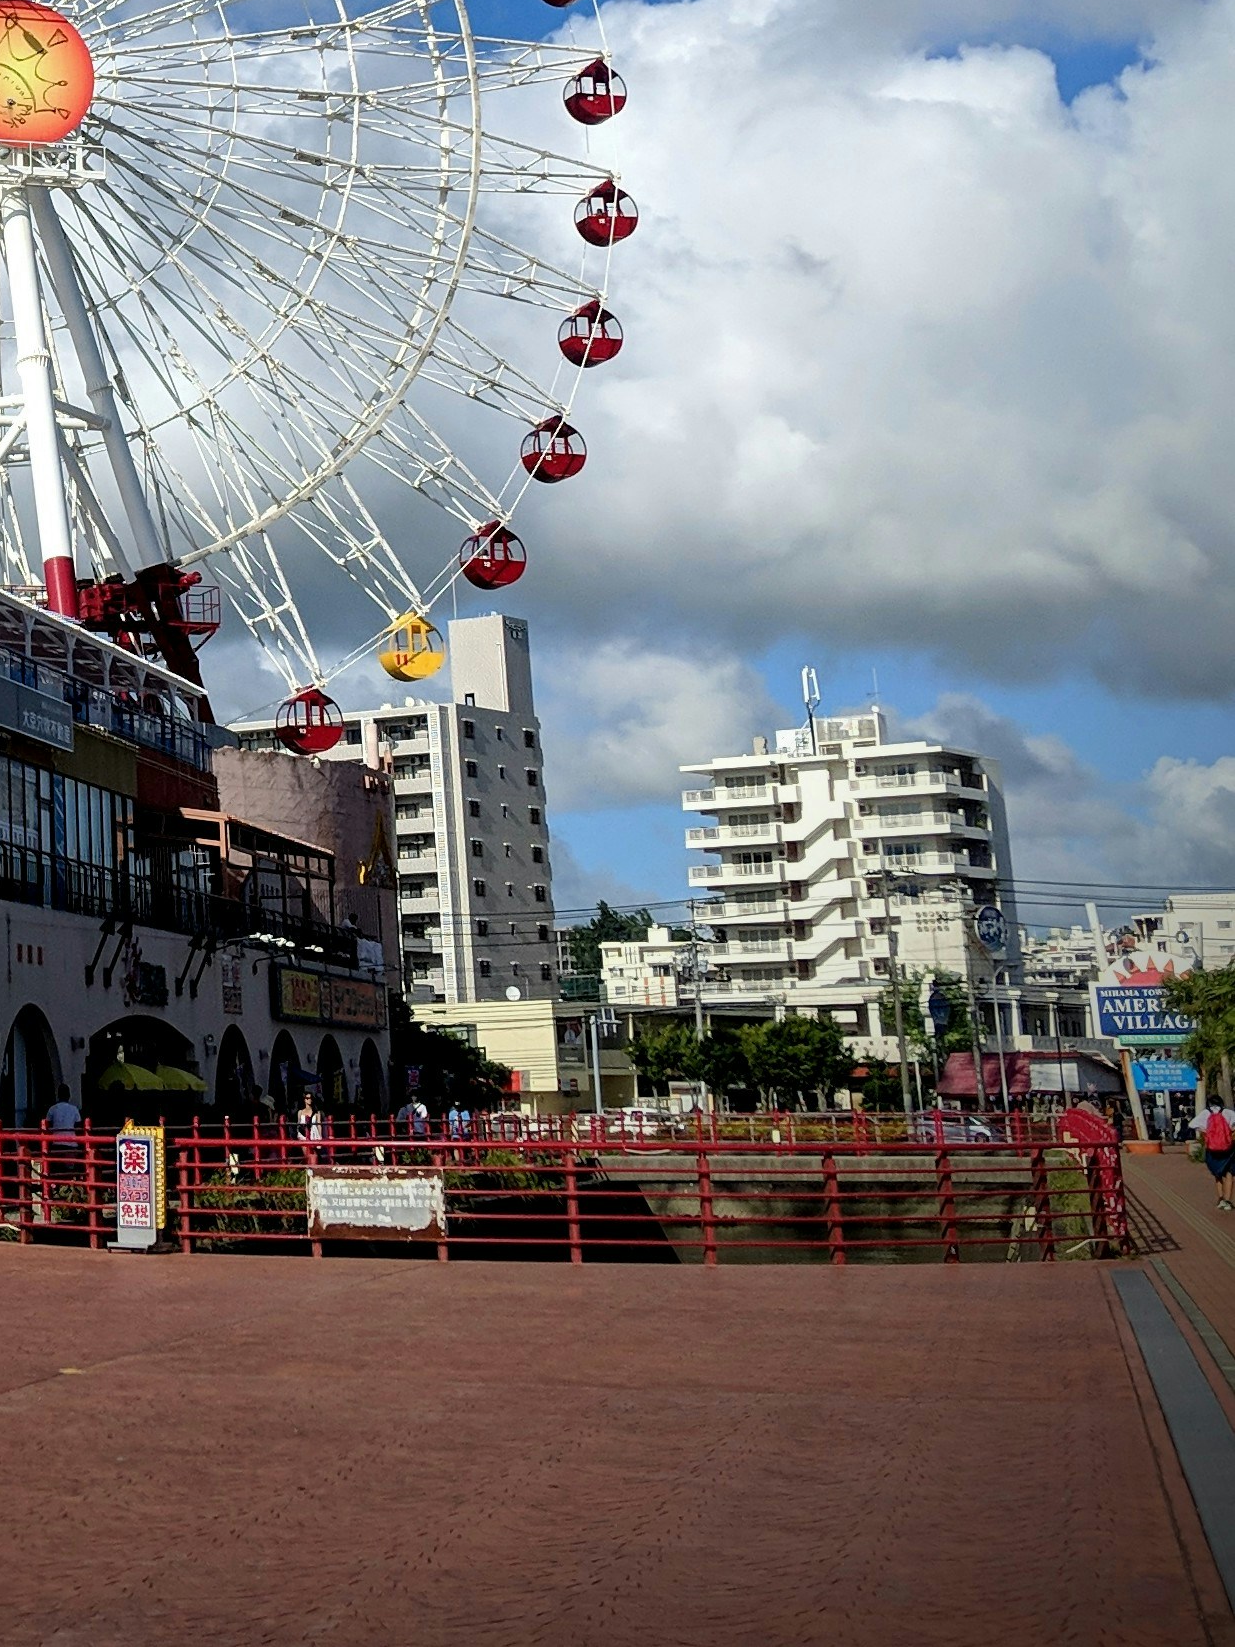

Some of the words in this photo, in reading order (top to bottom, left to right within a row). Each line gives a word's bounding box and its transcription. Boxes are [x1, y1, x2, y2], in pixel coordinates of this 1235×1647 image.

[395, 653, 409, 667] 11
[1100, 989, 1140, 998] MIHAMA
[121, 1141, 148, 1172] 薬
[120, 1203, 149, 1219] 免税
